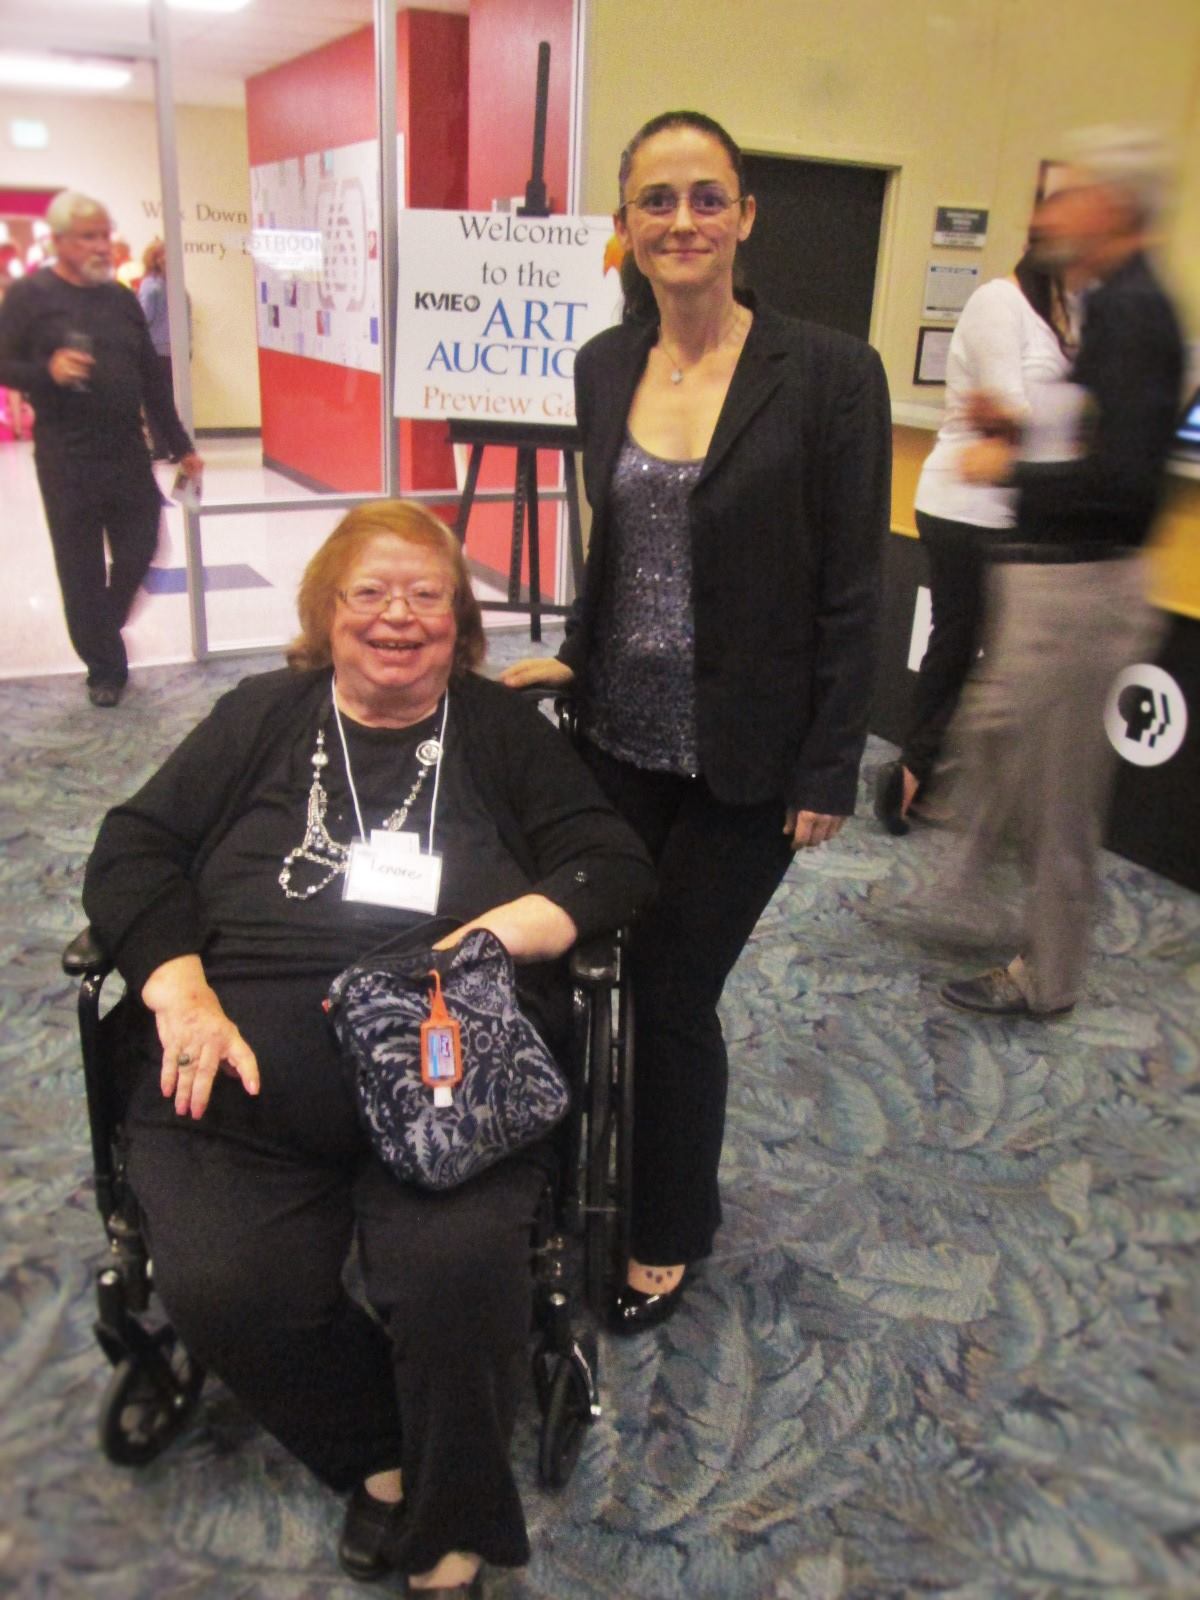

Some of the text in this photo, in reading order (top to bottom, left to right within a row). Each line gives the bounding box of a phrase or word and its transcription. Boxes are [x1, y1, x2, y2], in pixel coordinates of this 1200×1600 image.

[196, 203, 248, 224] Down
[459, 215, 589, 246] Welcome
[184, 241, 226, 260] mory
[481, 260, 560, 288] to the
[481, 298, 588, 342] ART
[426, 341, 577, 379] AUCTIO
[423, 386, 577, 418] Preview Ga
